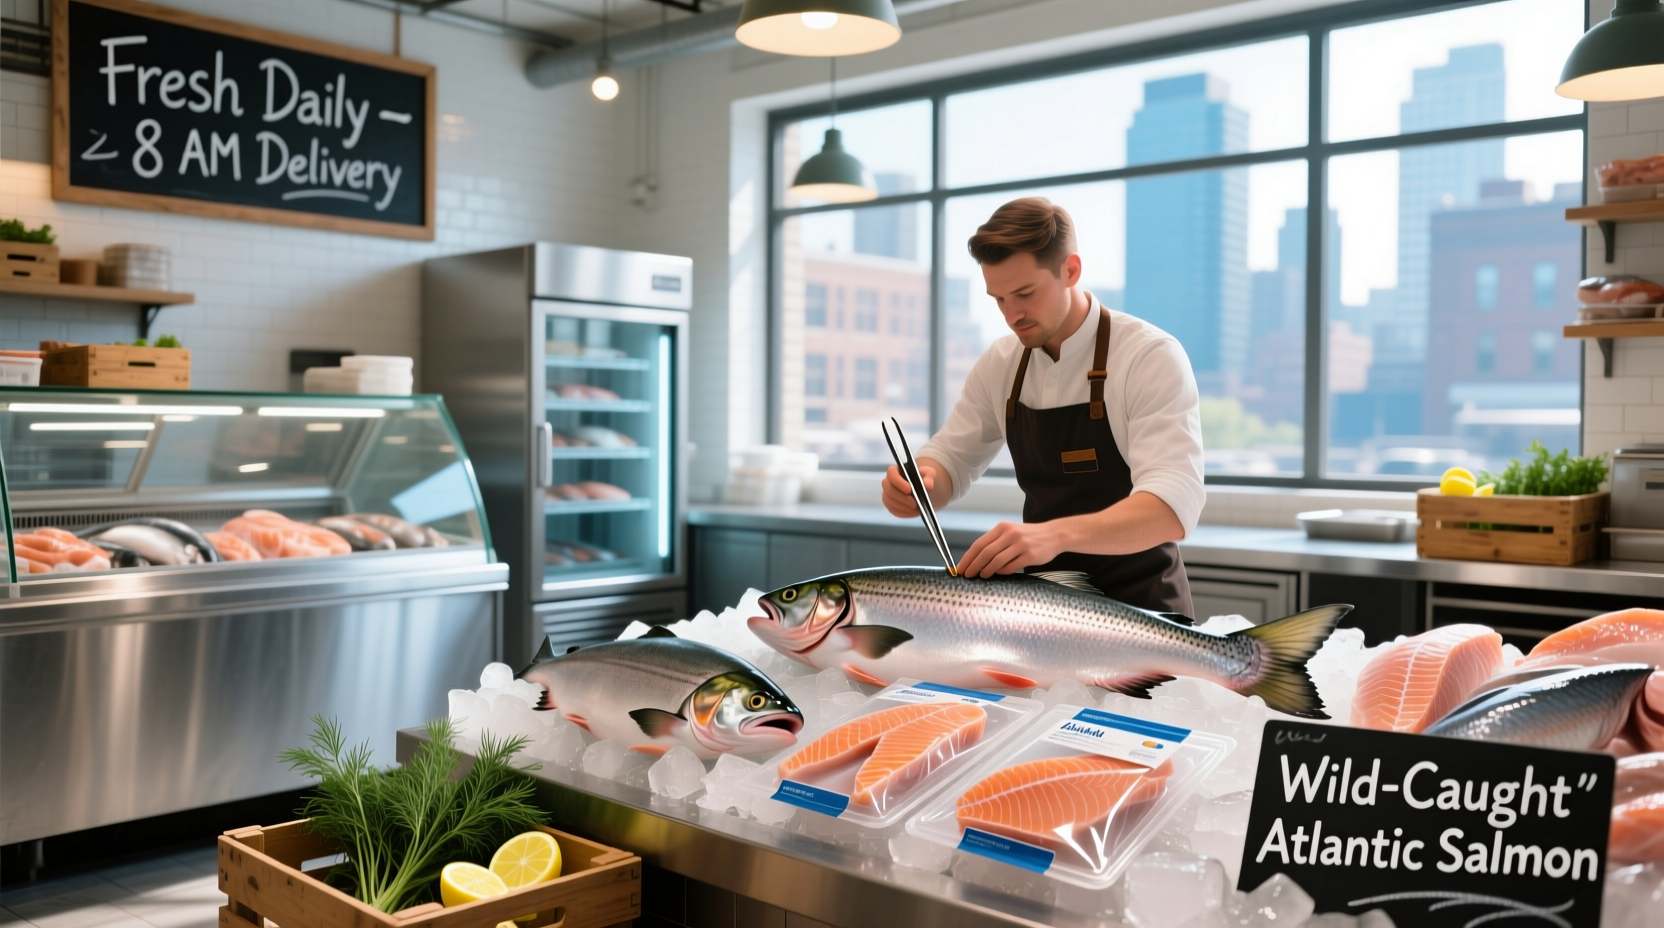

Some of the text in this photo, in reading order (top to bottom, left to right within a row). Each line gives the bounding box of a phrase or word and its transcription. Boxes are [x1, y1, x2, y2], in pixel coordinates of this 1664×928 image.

[100, 36, 243, 116] Fresh
[260, 59, 368, 149] Daily
[132, 119, 163, 179] 8
[179, 129, 241, 181] AM
[257, 132, 402, 211] Delivery
[1256, 818, 1598, 882] Atlantic Salmon
